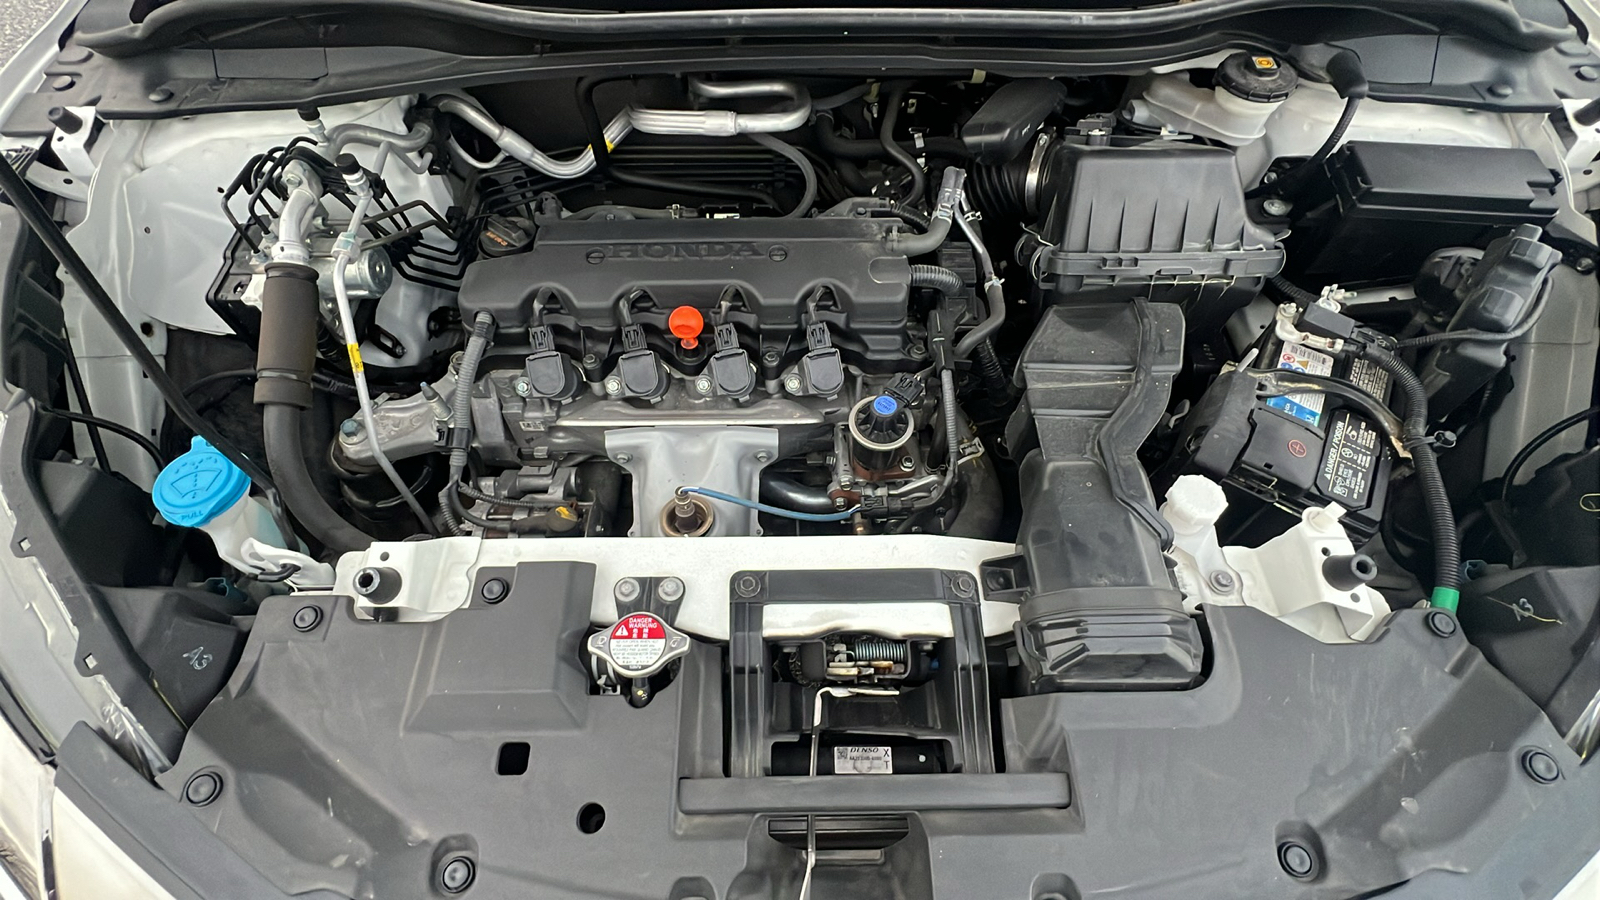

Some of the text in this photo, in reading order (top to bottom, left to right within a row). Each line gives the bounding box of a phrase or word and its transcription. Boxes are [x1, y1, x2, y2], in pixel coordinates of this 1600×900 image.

[608, 242, 767, 261] HONDA
[1325, 447, 1338, 473] DANGER
[1333, 421, 1345, 444] POISON
[181, 510, 204, 520] PULL
[883, 748, 890, 758] X
[883, 761, 890, 769] T
